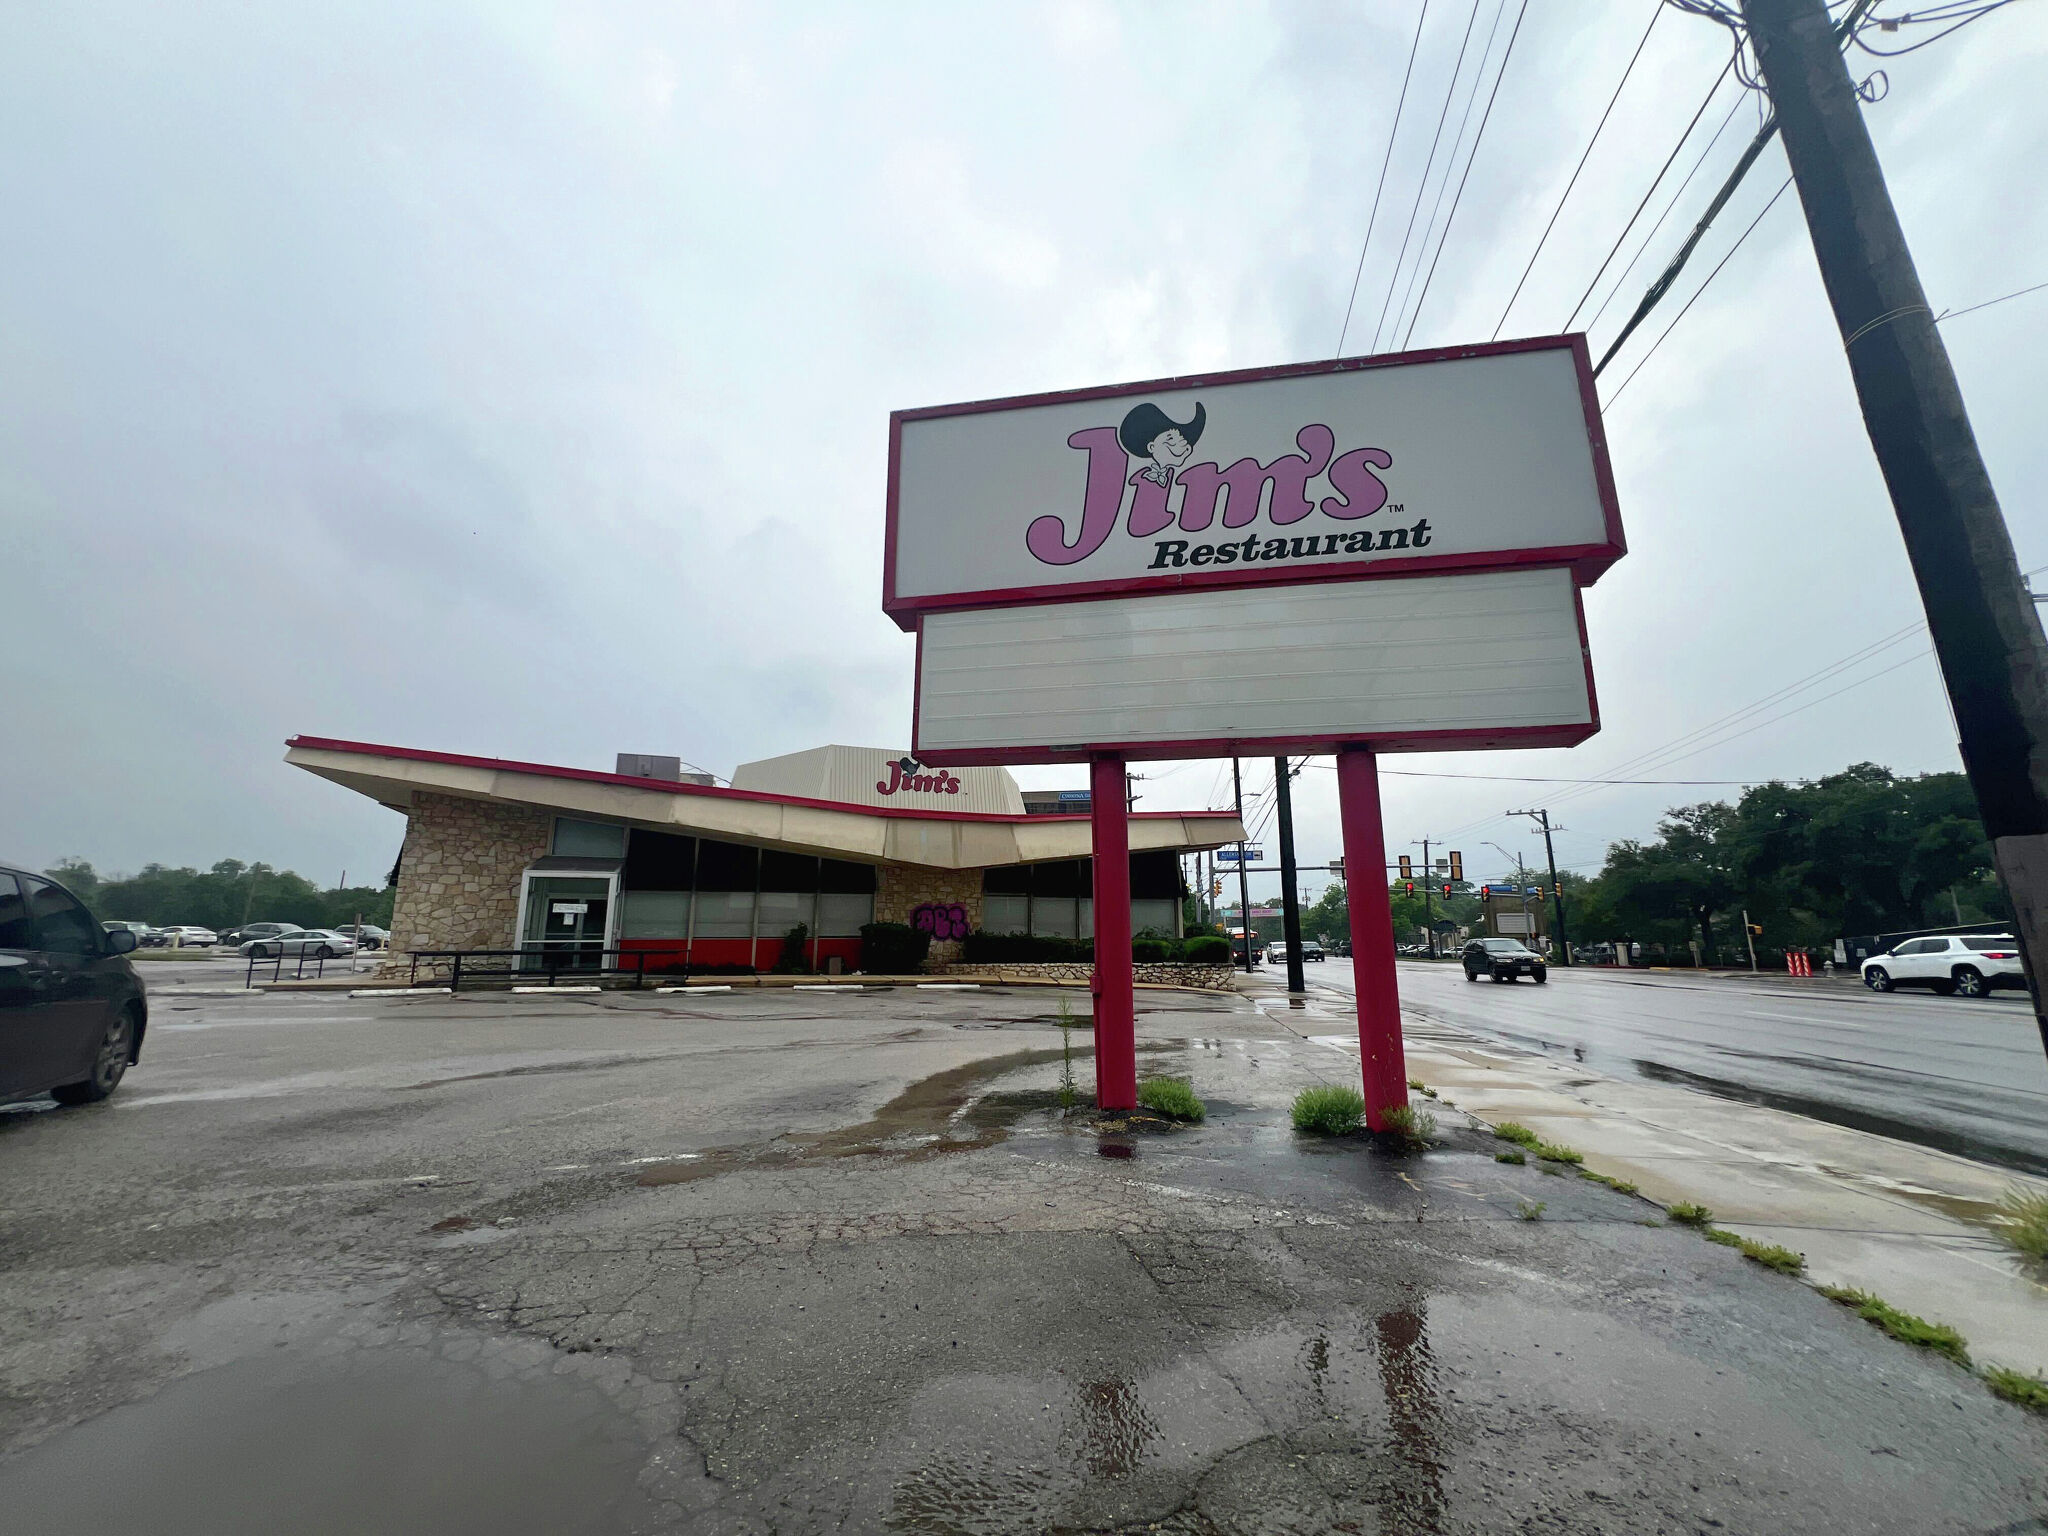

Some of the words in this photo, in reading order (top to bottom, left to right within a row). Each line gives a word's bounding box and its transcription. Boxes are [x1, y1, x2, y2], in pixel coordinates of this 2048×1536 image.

[1026, 423, 1393, 566] Jim's
[1147, 518, 1432, 570] Restaurant
[876, 760, 961, 796] Jim's
